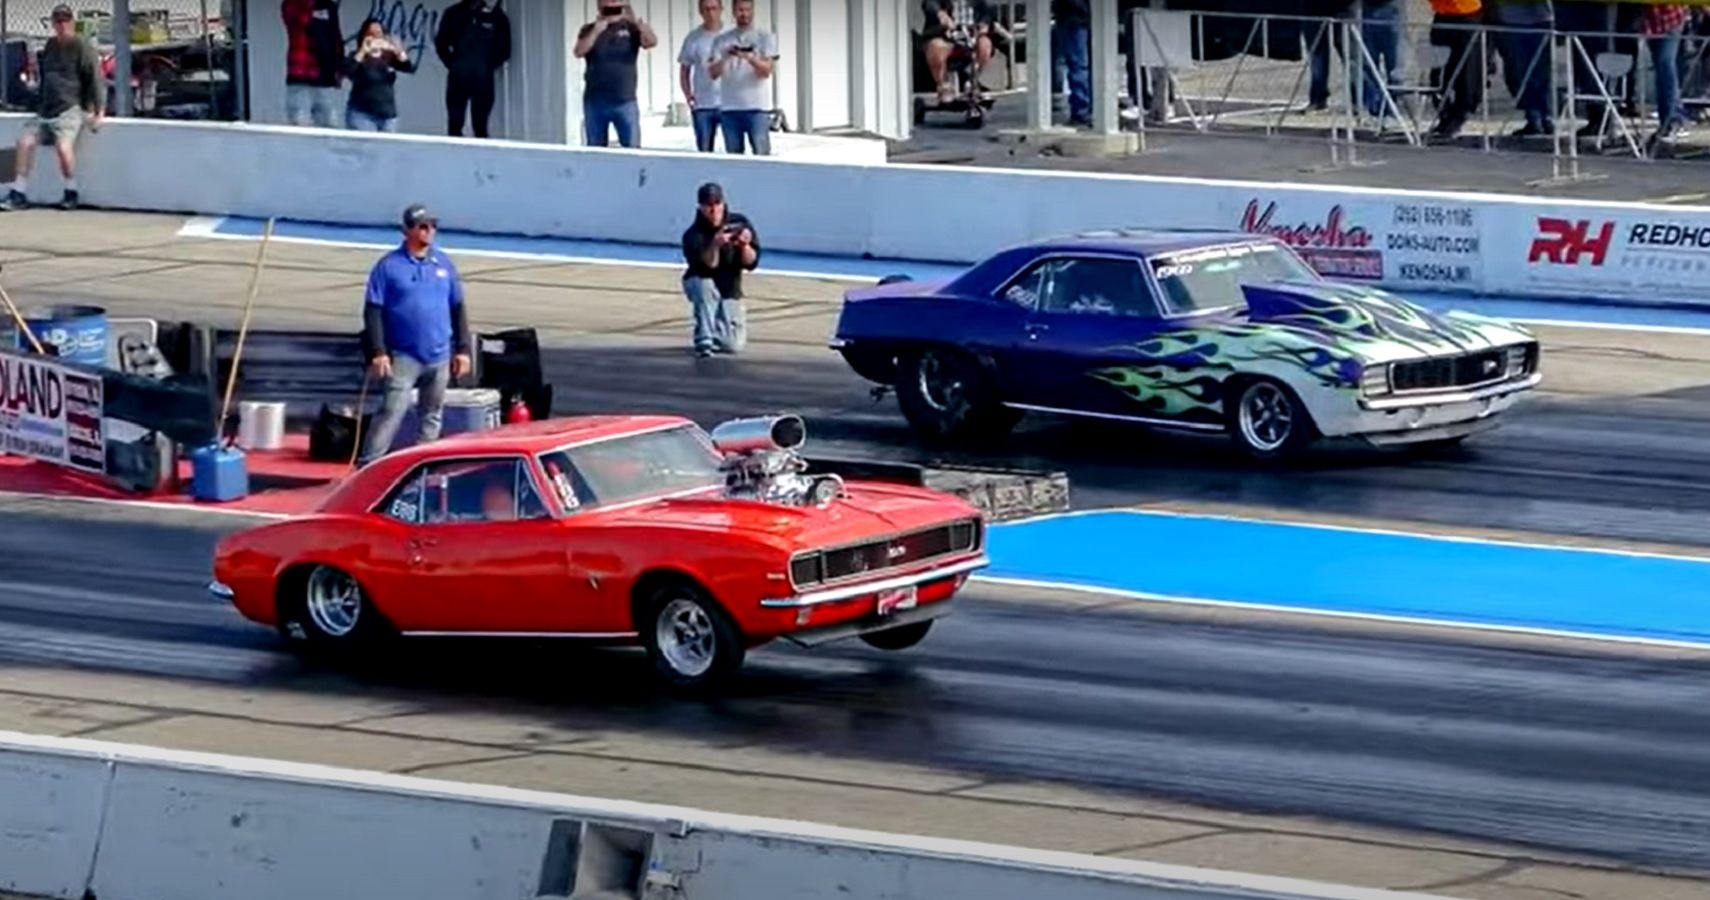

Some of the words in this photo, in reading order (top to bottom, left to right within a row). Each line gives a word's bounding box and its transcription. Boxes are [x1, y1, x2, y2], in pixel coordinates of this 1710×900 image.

[1528, 216, 1616, 267] RH
[1628, 223, 1710, 248] REDHO
[0, 359, 62, 419] LAND
